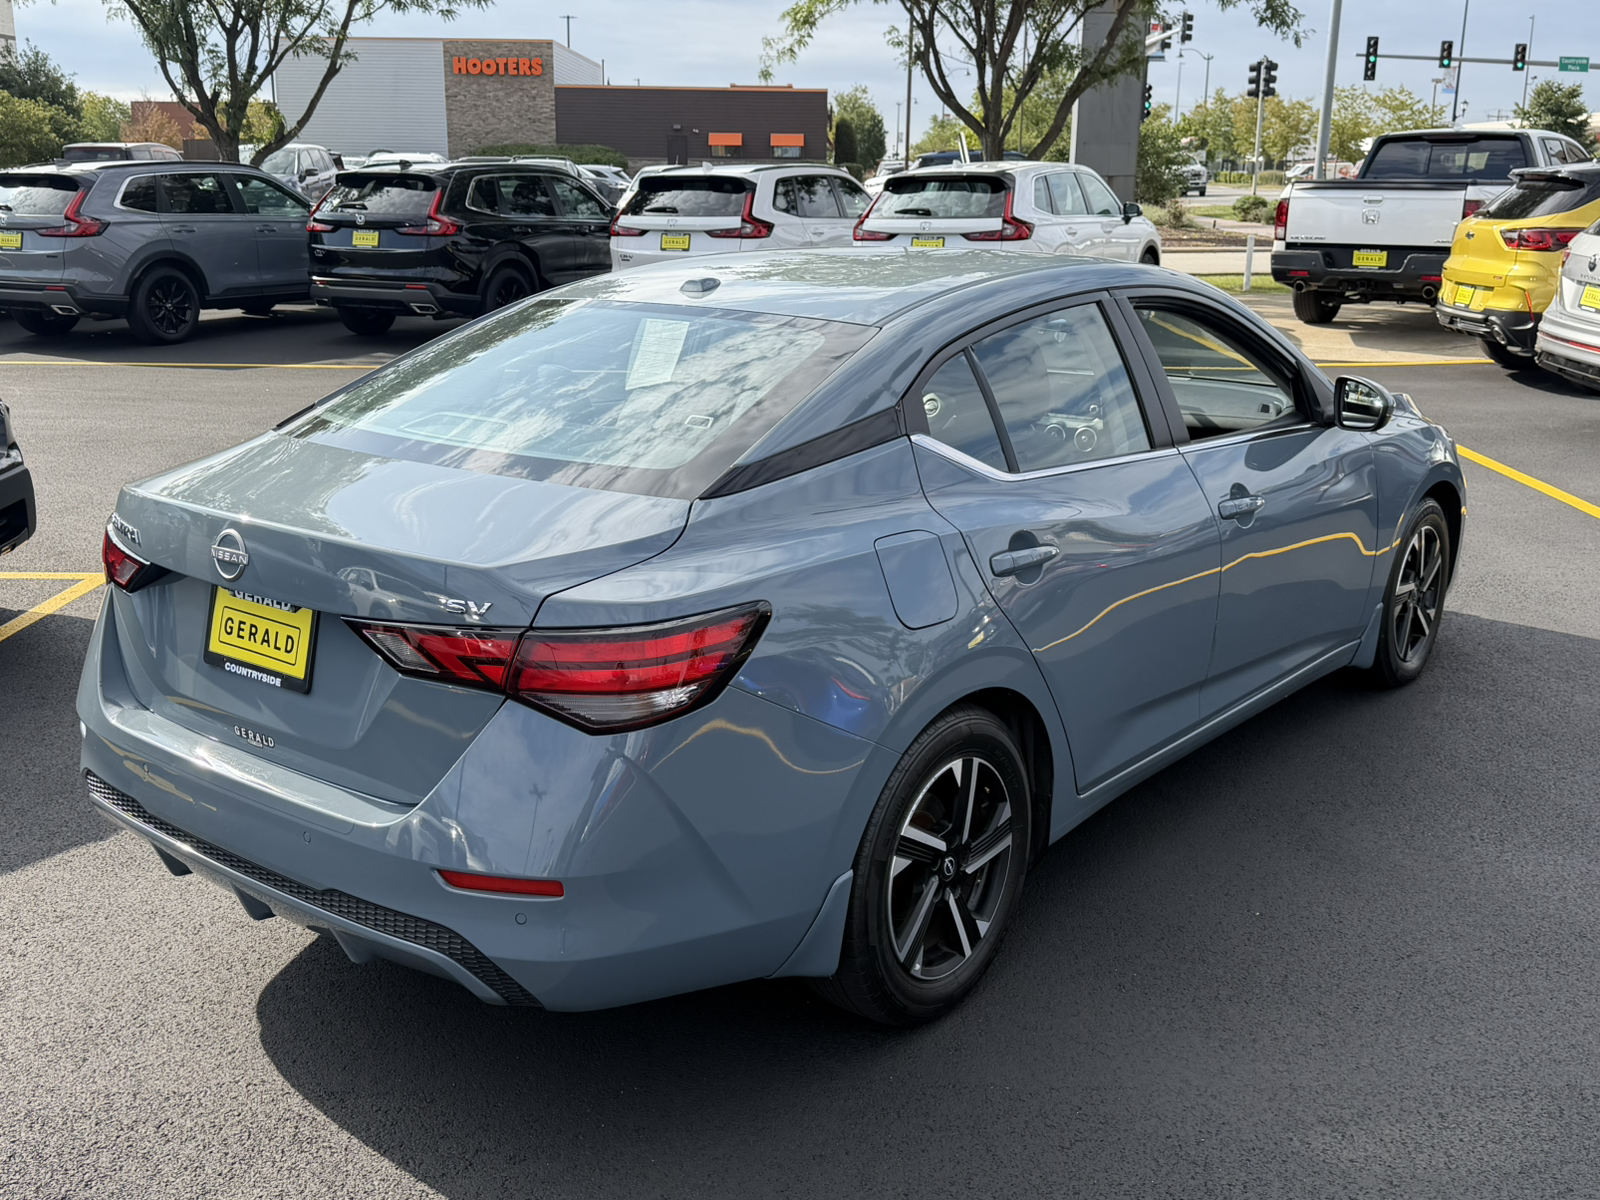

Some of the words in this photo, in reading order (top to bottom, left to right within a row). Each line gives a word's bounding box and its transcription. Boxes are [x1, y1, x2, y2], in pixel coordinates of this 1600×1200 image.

[453, 56, 543, 76] HOOTERS
[211, 547, 248, 565] NISSAN
[446, 599, 493, 616] SV
[224, 617, 295, 654] GERALD
[224, 662, 282, 687] COUNTRYSIDE
[234, 725, 275, 748] GERALD
